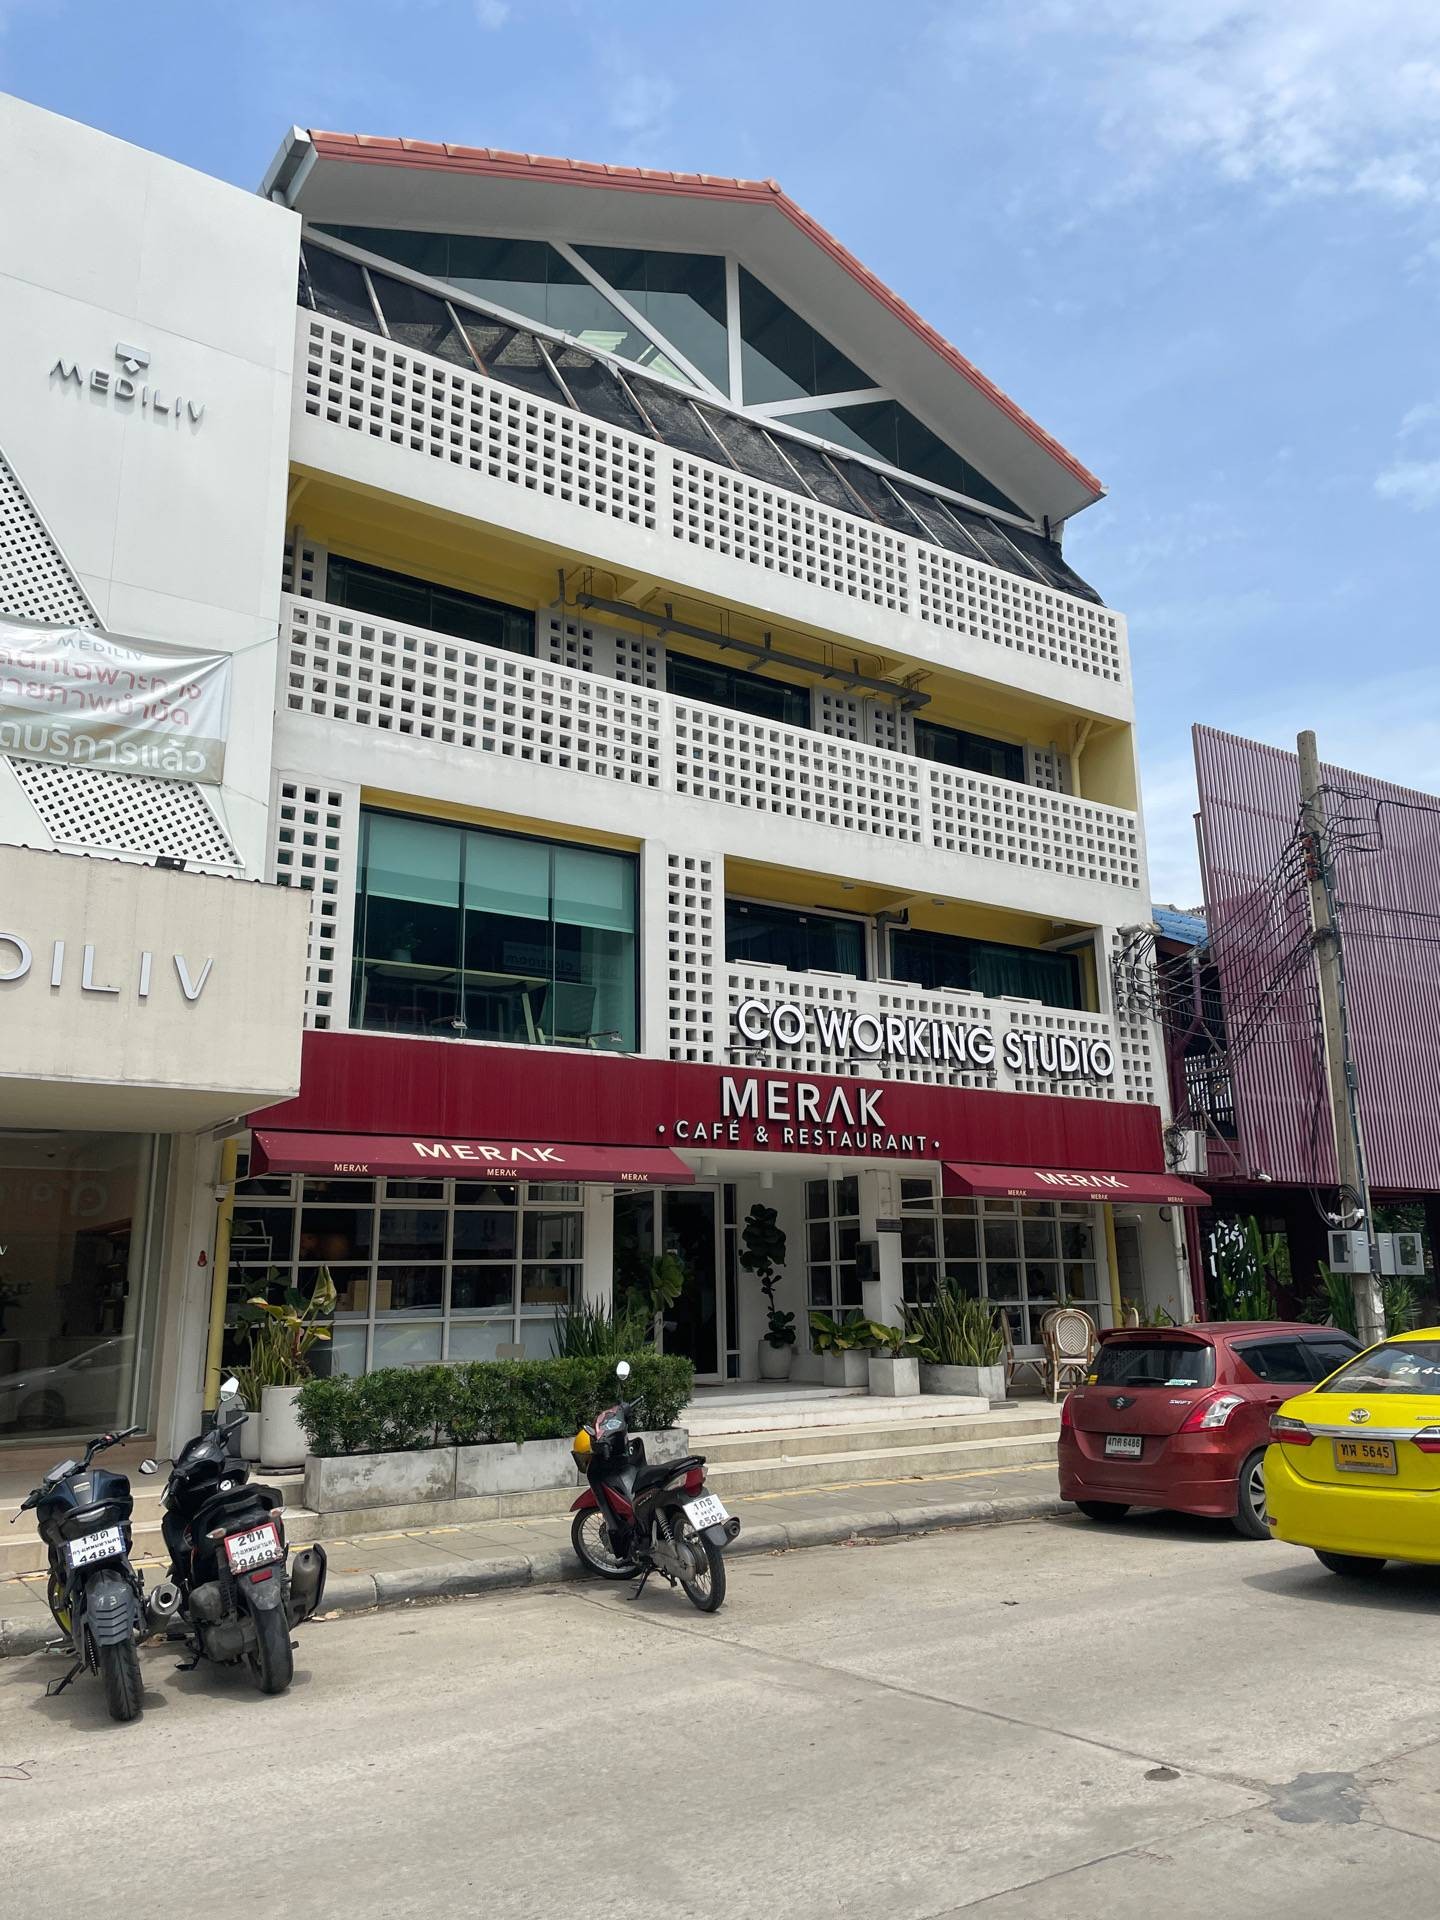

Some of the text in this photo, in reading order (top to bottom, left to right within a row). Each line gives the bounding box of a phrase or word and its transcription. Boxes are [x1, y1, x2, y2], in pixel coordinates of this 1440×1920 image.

[49, 357, 206, 422] MEDILIV
[57, 636, 143, 661] MEDILIV
[1003, 1031, 1115, 1078] STUDIO
[721, 1076, 886, 1128] MERAK
[675, 1119, 927, 1152] CAFÉ & RESTAURANT
[411, 1141, 566, 1163] MERAK
[334, 1163, 369, 1173] MERAK
[486, 1168, 518, 1178] MERAK
[621, 1172, 648, 1182] MERAK
[1034, 1171, 1130, 1189] MERAK
[1362, 1445, 1390, 1458] 5645
[80, 1545, 116, 1562] 4488
